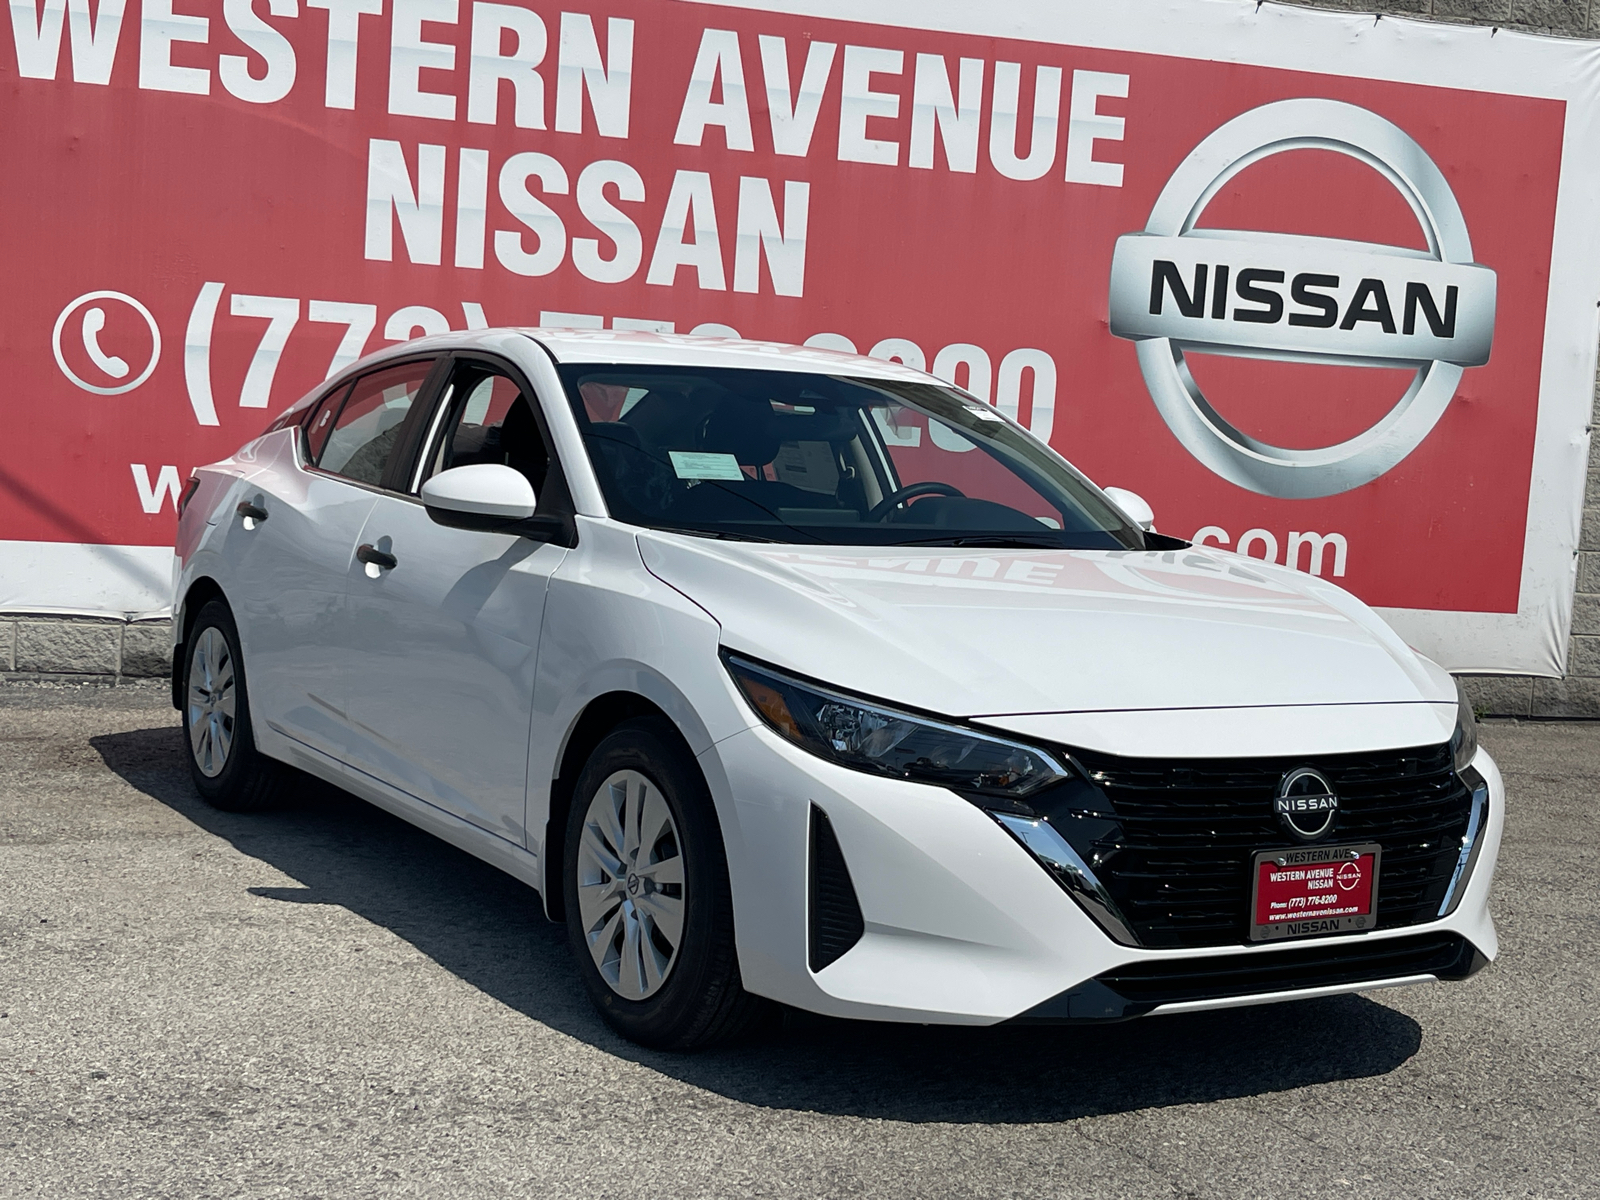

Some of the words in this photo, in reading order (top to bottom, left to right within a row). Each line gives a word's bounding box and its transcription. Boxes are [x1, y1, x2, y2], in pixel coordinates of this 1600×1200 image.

[8, 0, 635, 139] WESTERN
[673, 28, 1130, 187] AVENUE
[364, 138, 810, 297] NISSAN
[1149, 259, 1459, 338] NISSAN
[1278, 796, 1338, 811] NISSAN
[1286, 850, 1331, 863] WESTERN
[1270, 870, 1305, 882] WESTERN
[1306, 868, 1334, 880] AVENUE
[1336, 872, 1362, 880] NISSAN
[1307, 879, 1334, 890] NISSAN
[1288, 897, 1306, 909] (773)
[1307, 894, 1338, 906] 776-8200
[1287, 919, 1340, 935] NISSAN
